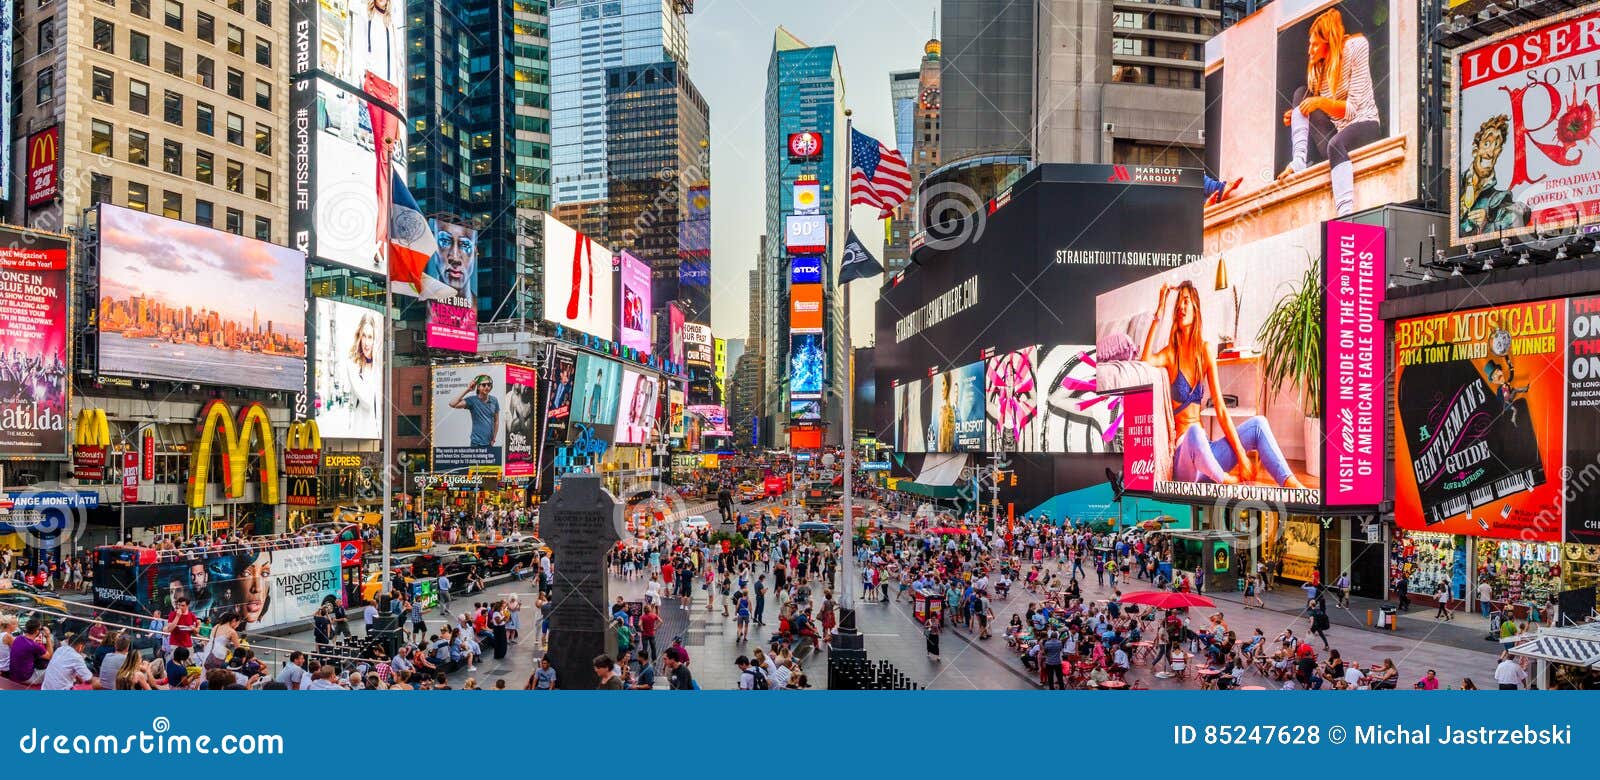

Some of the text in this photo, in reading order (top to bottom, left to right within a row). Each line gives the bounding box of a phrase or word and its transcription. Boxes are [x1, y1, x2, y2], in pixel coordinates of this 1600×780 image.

[296, 20, 309, 91] EXPRES
[296, 108, 309, 210] #EXPRESSLIFE
[32, 164, 53, 178] OPEN
[1135, 168, 1183, 176] MARRIOTT
[1135, 175, 1177, 183] MARQUIS
[34, 174, 51, 191] 24
[30, 187, 56, 202] HOURS
[1526, 191, 1567, 207] COMEDY
[1572, 187, 1583, 198] IN
[1056, 249, 1204, 268] STRAIGHTOUTTASOMEWHERECOM
[1341, 234, 1355, 272] LEVEL
[31, 275, 42, 285] IN
[1340, 299, 1355, 325] THE
[1399, 303, 1557, 350] BEST MUSICAL!
[1340, 328, 1354, 348] ON
[1399, 335, 1556, 366] 2014 TONY AWARD WINNER
[1358, 251, 1374, 476] OF AMERICAN EAGLE OUTFITTERS
[1340, 353, 1354, 400] INSIDE
[0, 401, 64, 431] atilda
[955, 420, 984, 433] BLINDSPOT
[1414, 378, 1487, 485] GENTLEMAN'S
[1419, 425, 1432, 442] A
[1141, 436, 1154, 447] LEVE
[325, 455, 361, 467] EXPRESS
[1445, 440, 1492, 474] GUIDE
[1339, 455, 1354, 493] VISIT
[8, 496, 96, 506] HANGE MONEY ATM
[1154, 481, 1319, 504] AMERICAN EAGLE OUTFITTERS
[1500, 542, 1561, 563] GRAND
[276, 568, 337, 587] MINORITY
[284, 578, 338, 597] REPORT
